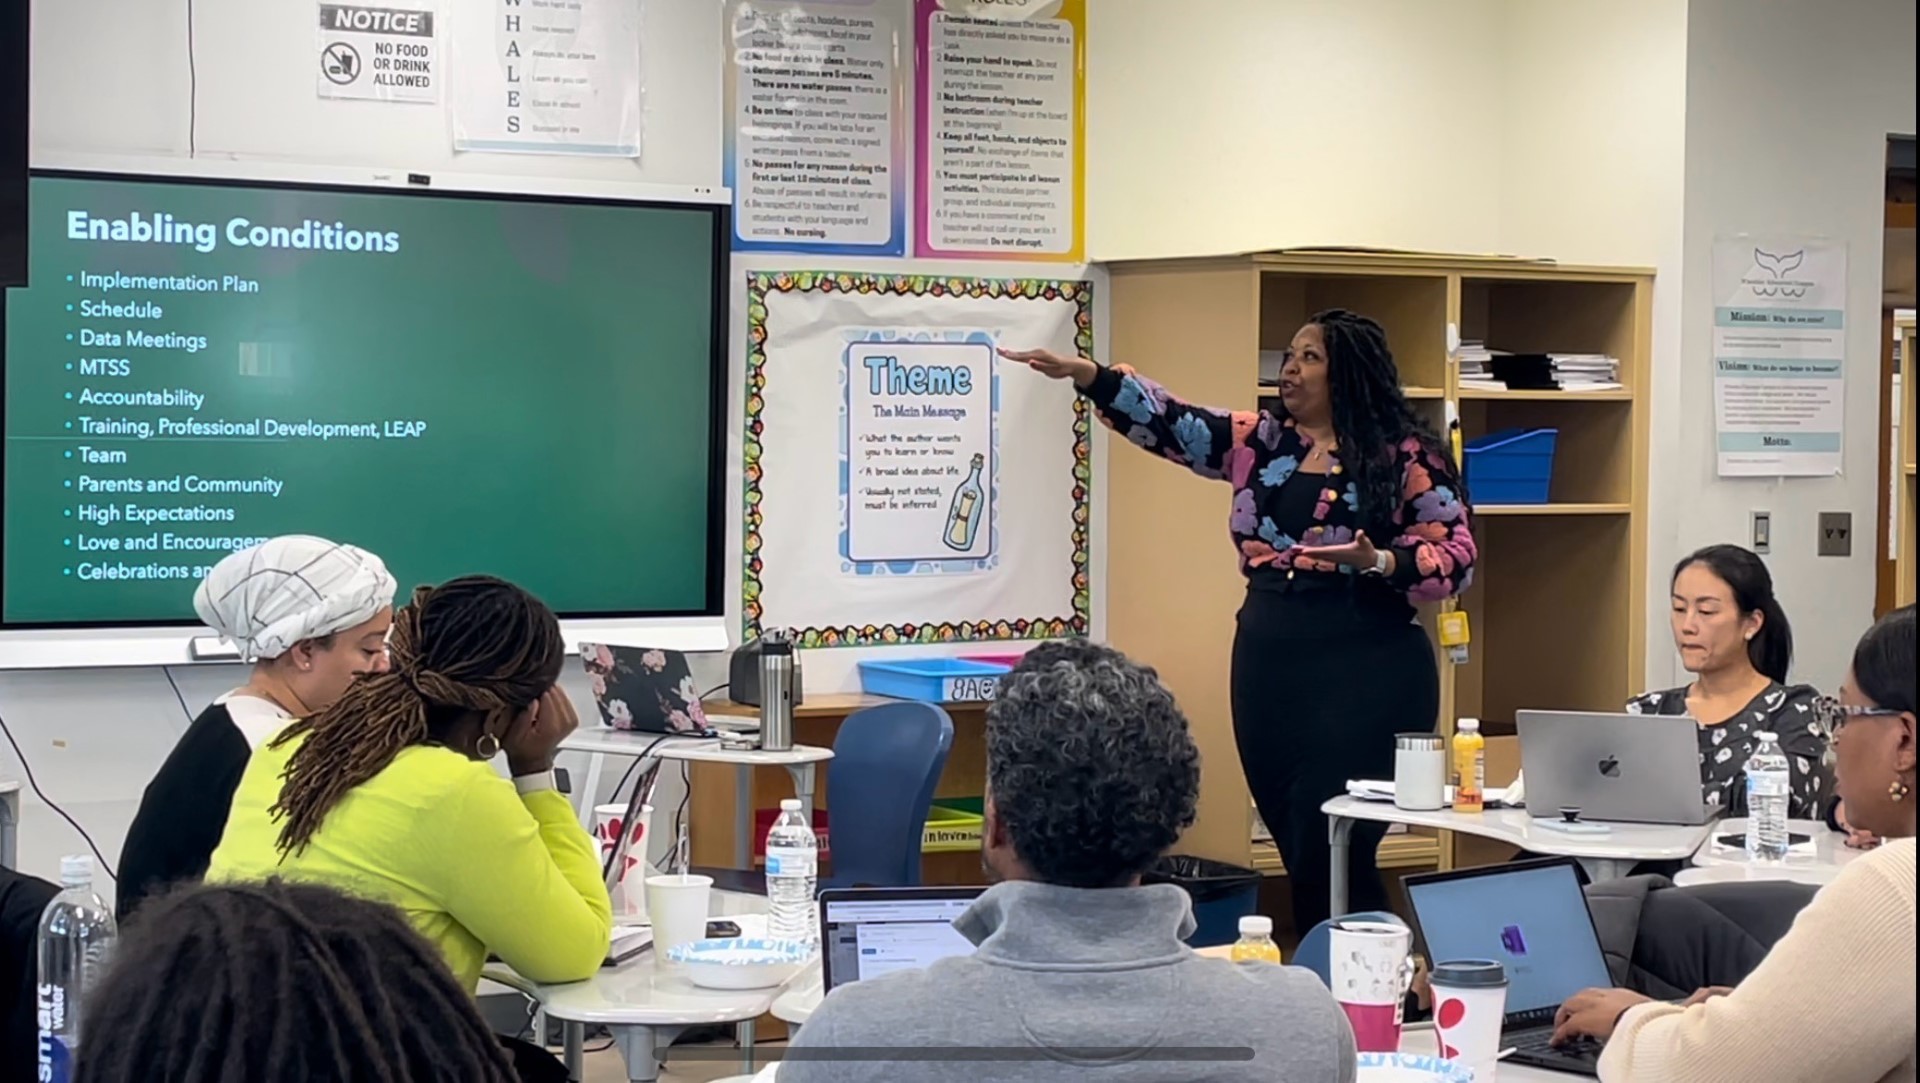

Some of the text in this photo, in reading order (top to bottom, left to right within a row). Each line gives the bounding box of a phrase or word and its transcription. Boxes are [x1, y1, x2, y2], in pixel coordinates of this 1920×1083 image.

[335, 8, 419, 33] NOTICE
[944, 15, 971, 24] Remain
[375, 42, 429, 58] NO FOOD
[752, 52, 763, 60] No
[373, 57, 430, 73] OR DRINK
[944, 53, 965, 63] Raise
[966, 57, 982, 65] your
[983, 56, 1002, 64] hand
[752, 66, 790, 75] Bathroom
[792, 70, 820, 78] passes
[373, 73, 430, 88] ALLOWED
[752, 79, 774, 88] There
[943, 93, 1043, 106] No bathroom during teacher
[752, 105, 762, 114] Be
[943, 132, 962, 141] Keep
[1032, 136, 1057, 146] objects
[752, 159, 763, 167] No
[764, 162, 792, 170] passes
[793, 161, 805, 169] for
[848, 163, 873, 174] during
[874, 164, 887, 172] the
[752, 172, 770, 181] first
[780, 174, 796, 182] last
[808, 175, 840, 184] minutes
[841, 176, 849, 184] of
[979, 173, 1019, 184] participate
[67, 210, 399, 253] Enabling Conditions
[784, 228, 795, 236] No
[991, 237, 1000, 245] Do
[81, 270, 259, 293] Implementation Plan
[80, 299, 163, 319] Schedule
[80, 328, 208, 353] Data Meetings
[80, 358, 131, 377] MTSS
[863, 356, 972, 395] Theme
[78, 387, 205, 411] Accountability
[873, 404, 966, 421] The Main Message
[78, 416, 427, 441] Training, Professional Development, LEAP
[866, 434, 961, 442] What the author wants
[78, 446, 127, 464] Team
[865, 449, 880, 460] you
[884, 448, 892, 456] to
[895, 448, 917, 456] learn
[933, 447, 954, 456] know
[866, 467, 872, 476] A
[876, 467, 898, 476] broad
[902, 467, 918, 476] idea
[921, 467, 944, 476] about
[79, 475, 284, 497] Parents and Community
[866, 486, 894, 499] Usually
[898, 487, 910, 495] not
[865, 501, 886, 509] must
[890, 501, 898, 509] be
[78, 503, 235, 526] High Expectations
[78, 533, 121, 551] Love
[124, 532, 158, 551] and
[77, 561, 190, 580] Celebrations
[52, 984, 64, 1030] water
[38, 982, 52, 1083] smart
